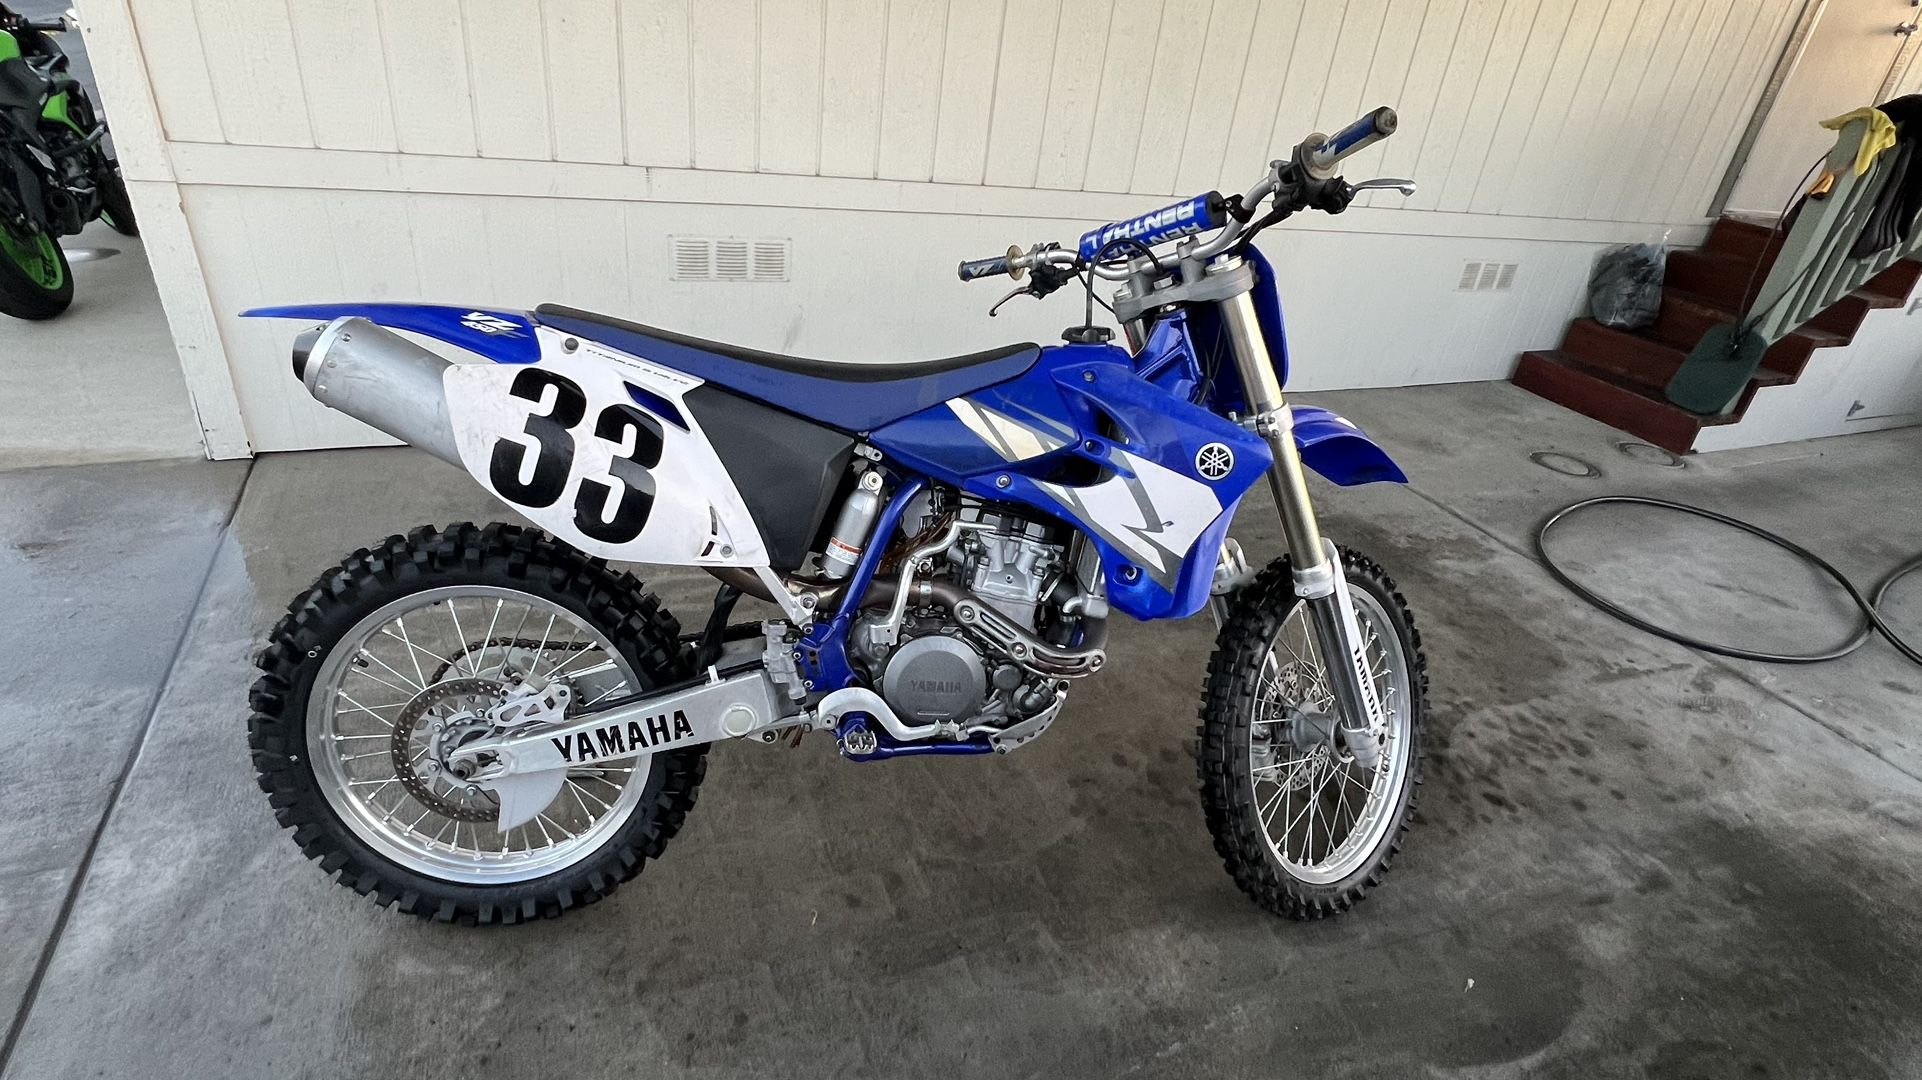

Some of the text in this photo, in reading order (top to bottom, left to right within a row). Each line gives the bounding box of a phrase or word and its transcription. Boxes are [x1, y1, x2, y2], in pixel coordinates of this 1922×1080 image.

[1085, 201, 1196, 249] RENTHAL
[489, 367, 665, 545] 33
[910, 680, 962, 694] YAMAHA
[550, 709, 695, 763] YAMAHA
